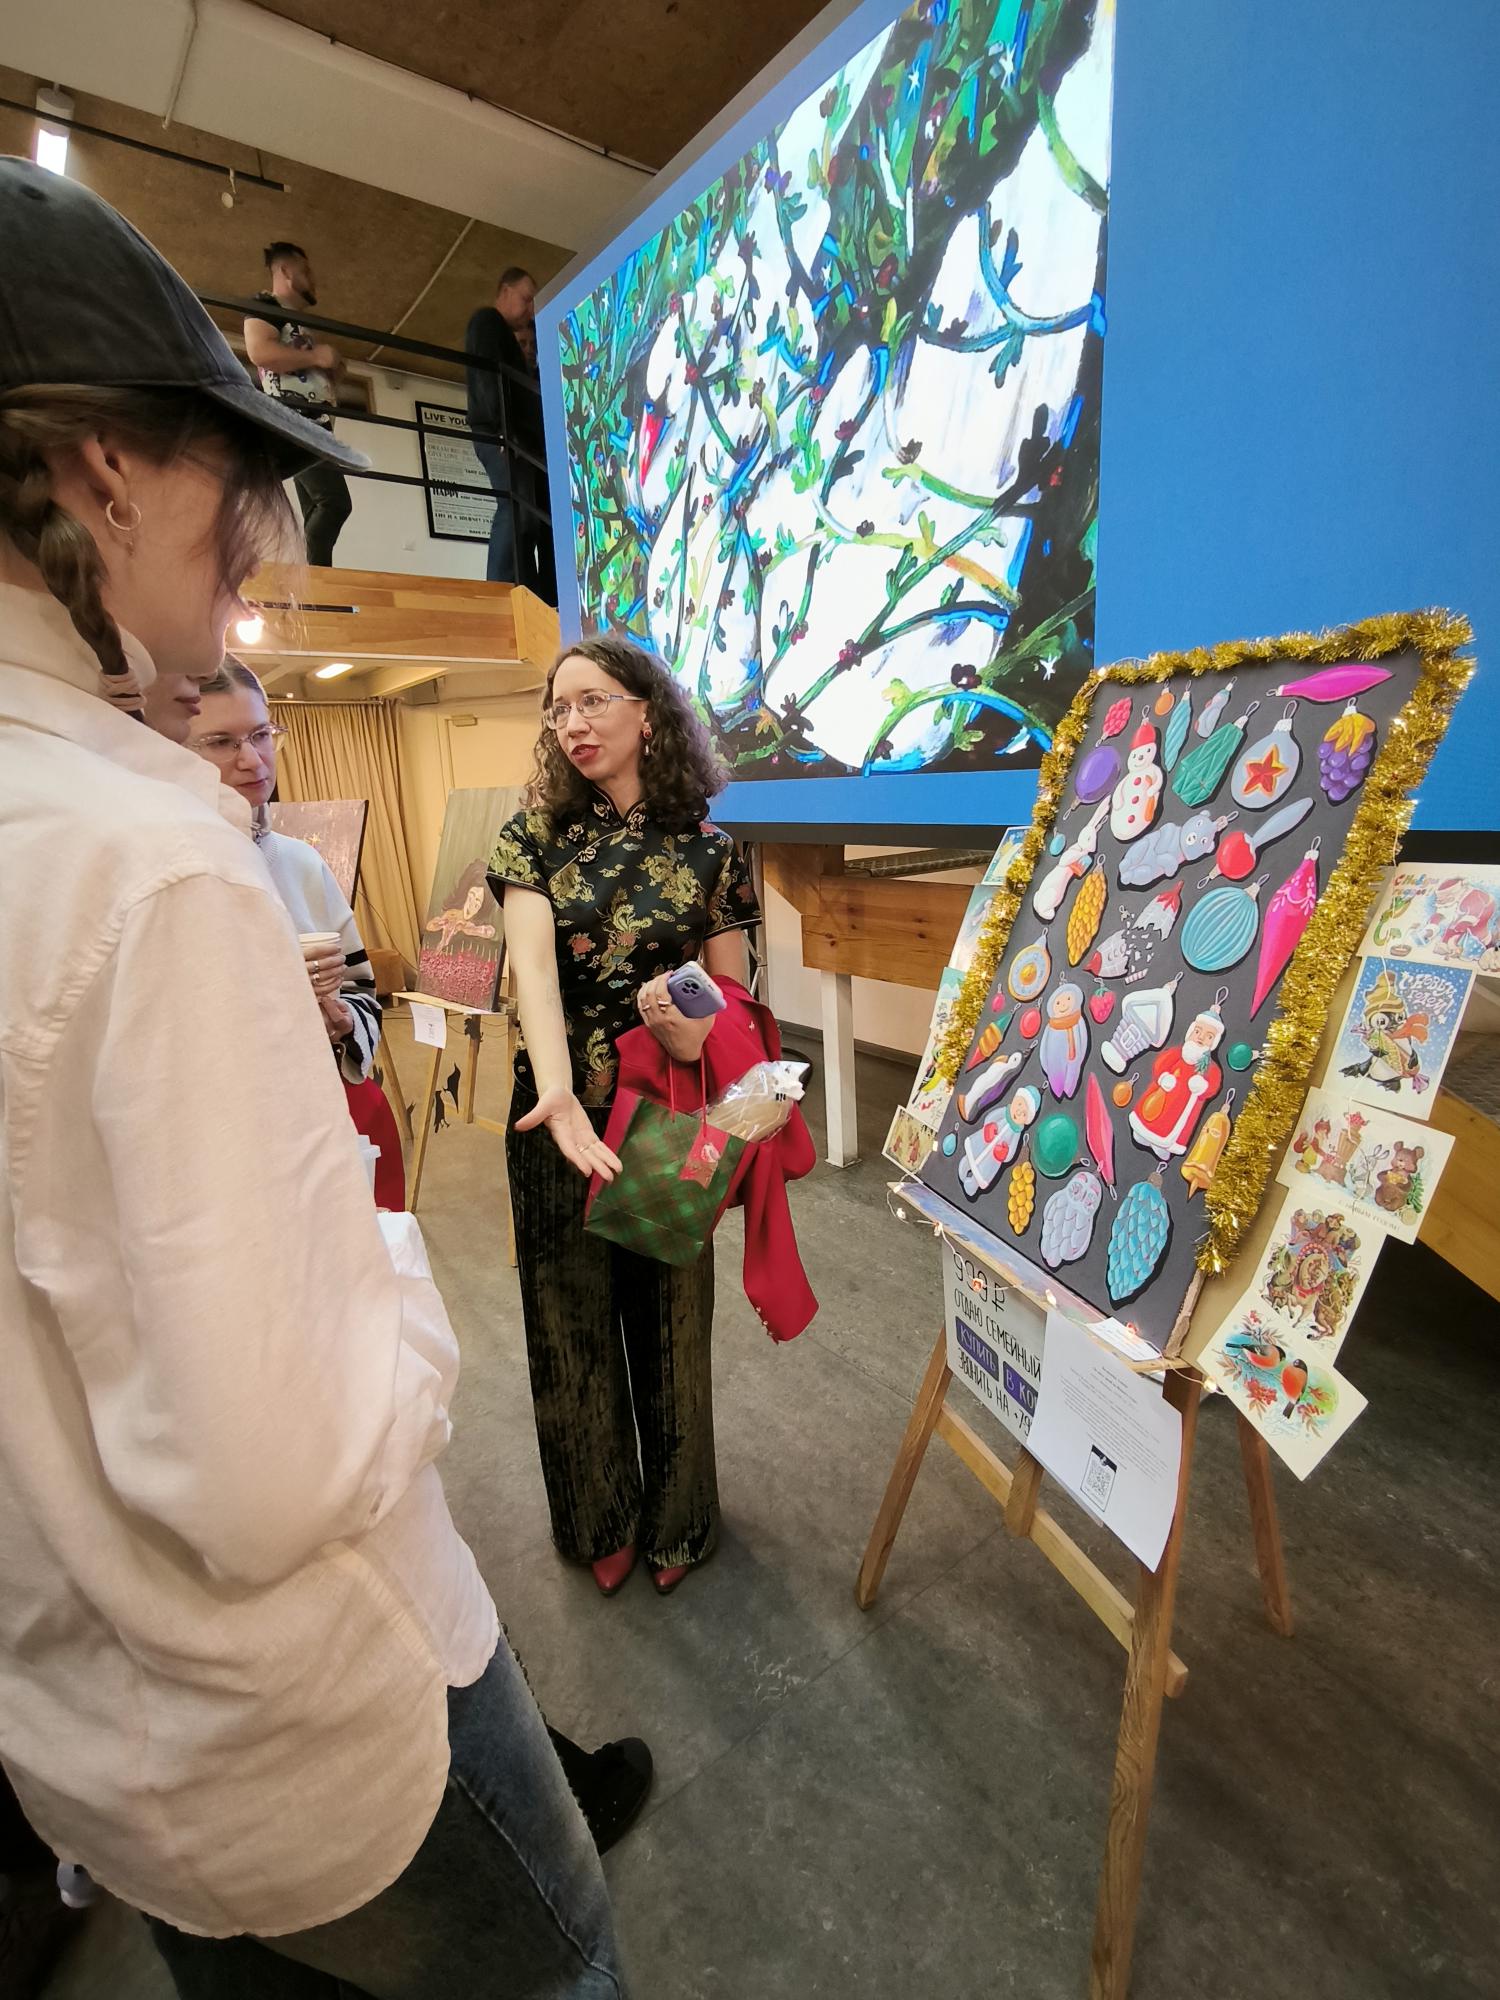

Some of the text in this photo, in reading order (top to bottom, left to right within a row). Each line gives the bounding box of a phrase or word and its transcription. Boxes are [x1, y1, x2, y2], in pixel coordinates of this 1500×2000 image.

[424, 411, 446, 422] LIVE
[954, 1287, 983, 1328] ОТДАЮ
[985, 1315, 1041, 1382] СЕМЕЙНЫЙ
[959, 1328, 996, 1372] КУПИТЬ
[1006, 1368, 1015, 1391] В
[958, 1347, 993, 1399] ЗВОНИТЬ
[996, 1385, 1010, 1417] НА
